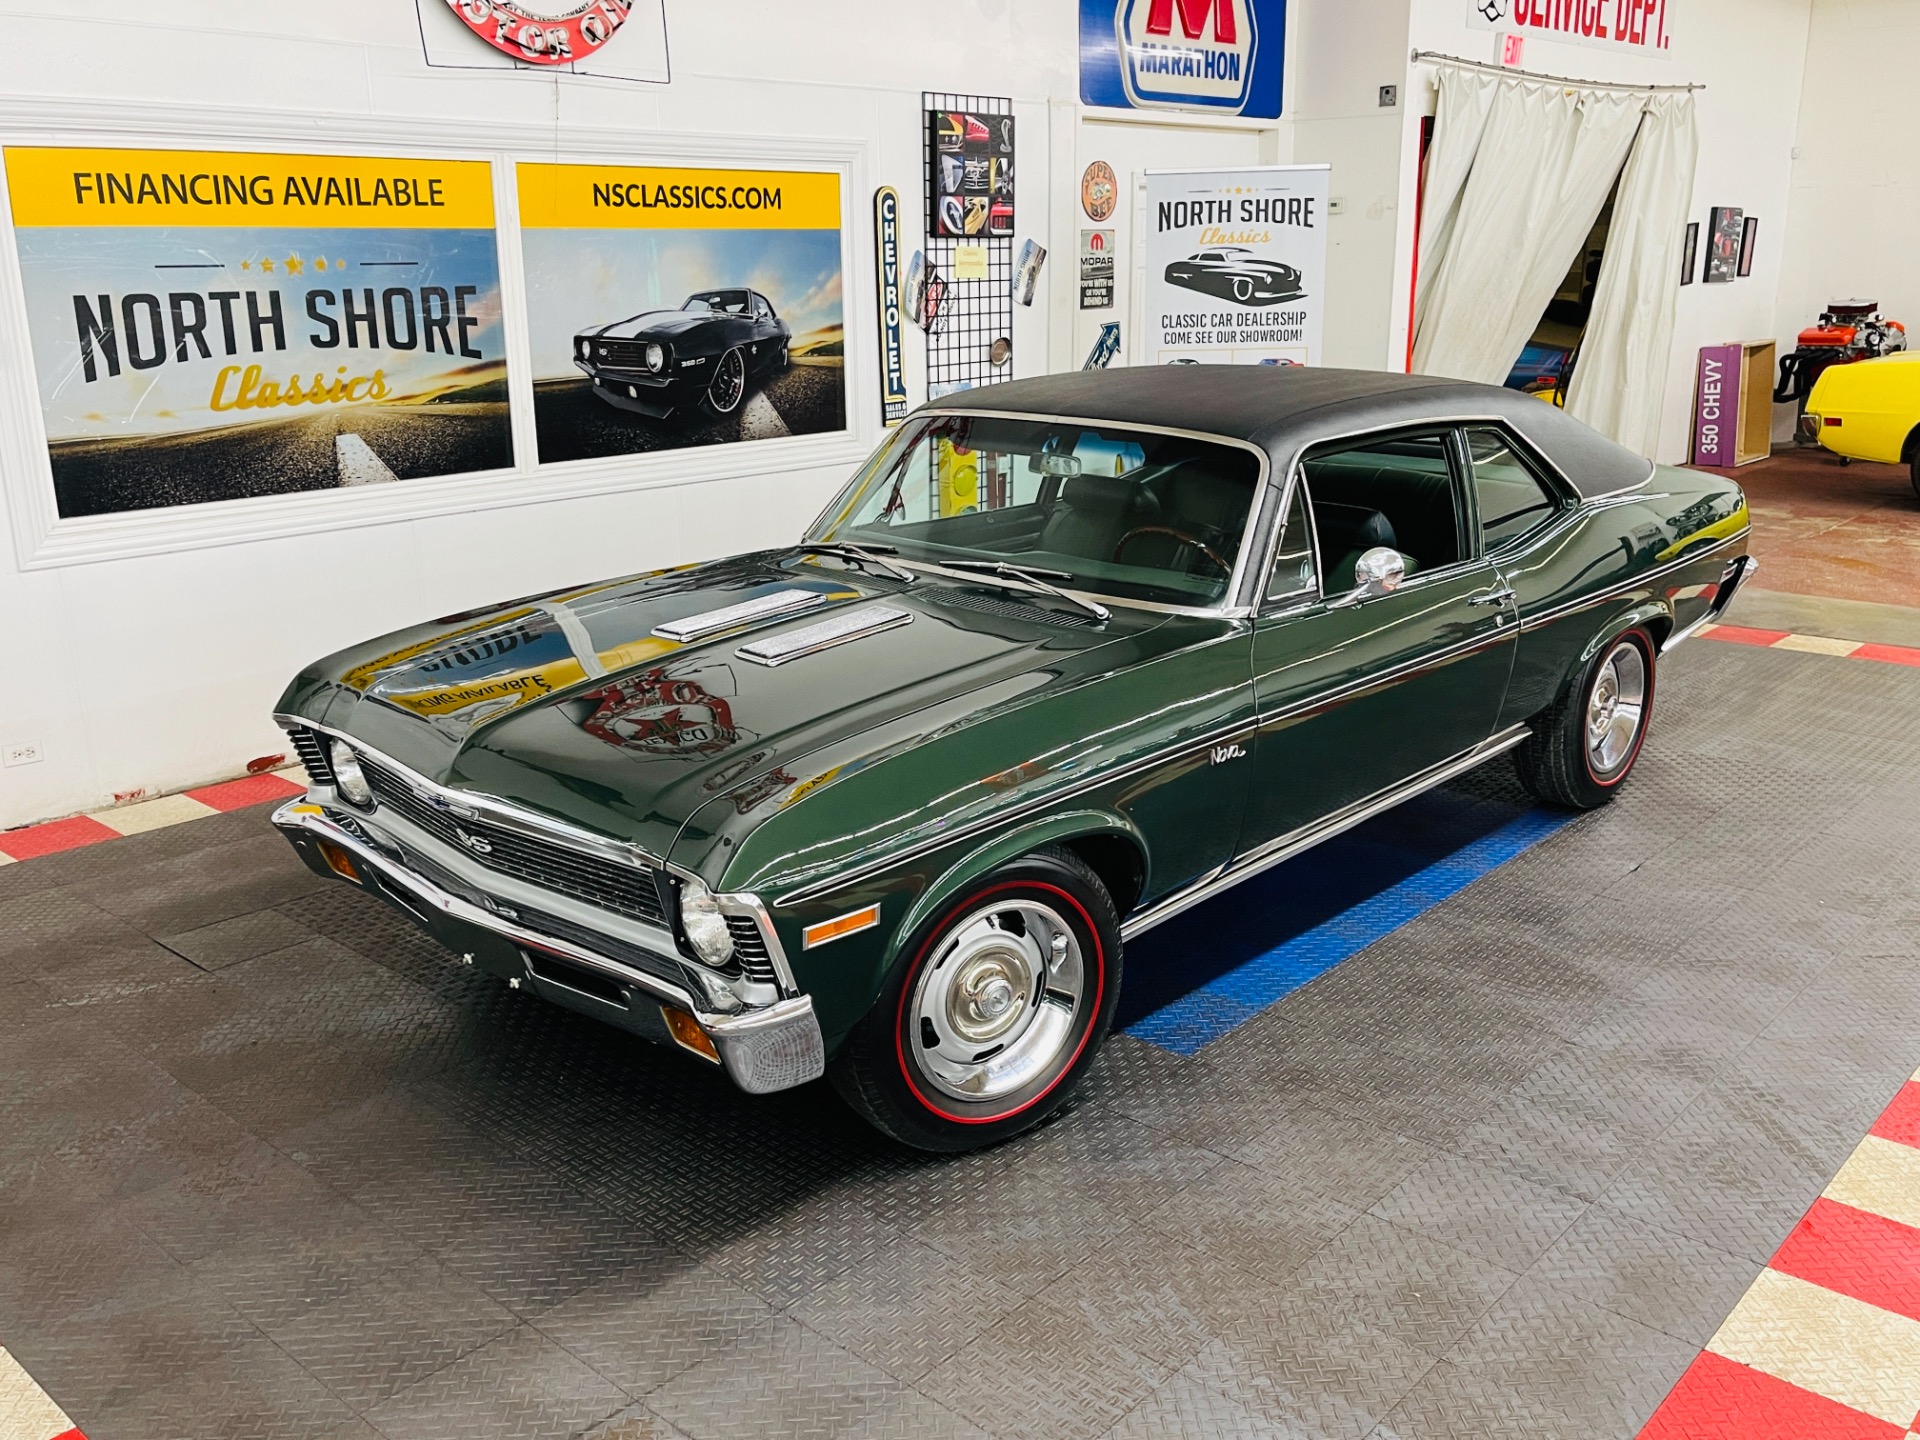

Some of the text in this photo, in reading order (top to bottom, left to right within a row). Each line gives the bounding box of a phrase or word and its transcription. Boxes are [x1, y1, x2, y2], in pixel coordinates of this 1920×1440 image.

[1139, 42, 1240, 82] MARATHON
[1504, 35, 1524, 65] EXIT
[73, 172, 445, 207] FINANCING AVAILABLE
[593, 183, 782, 210] NSCLASSICS.COM
[1158, 197, 1315, 232] NORTH SHORE
[1199, 227, 1272, 246] Classics
[1020, 248, 1032, 269] SHORE
[1081, 257, 1113, 266] MOPAR
[883, 199, 900, 391] CHEVROLET
[72, 285, 483, 383] NORTH SHORE
[1161, 311, 1307, 329] CLASSIC CAR DEALERSHIP
[1164, 329, 1303, 345] COME SEE OUR SHOWROOM!
[209, 364, 396, 412] Classics
[886, 410, 907, 419] SERVICE
[1701, 358, 1723, 454] 350 CHEVY
[1208, 744, 1247, 766] Nova
